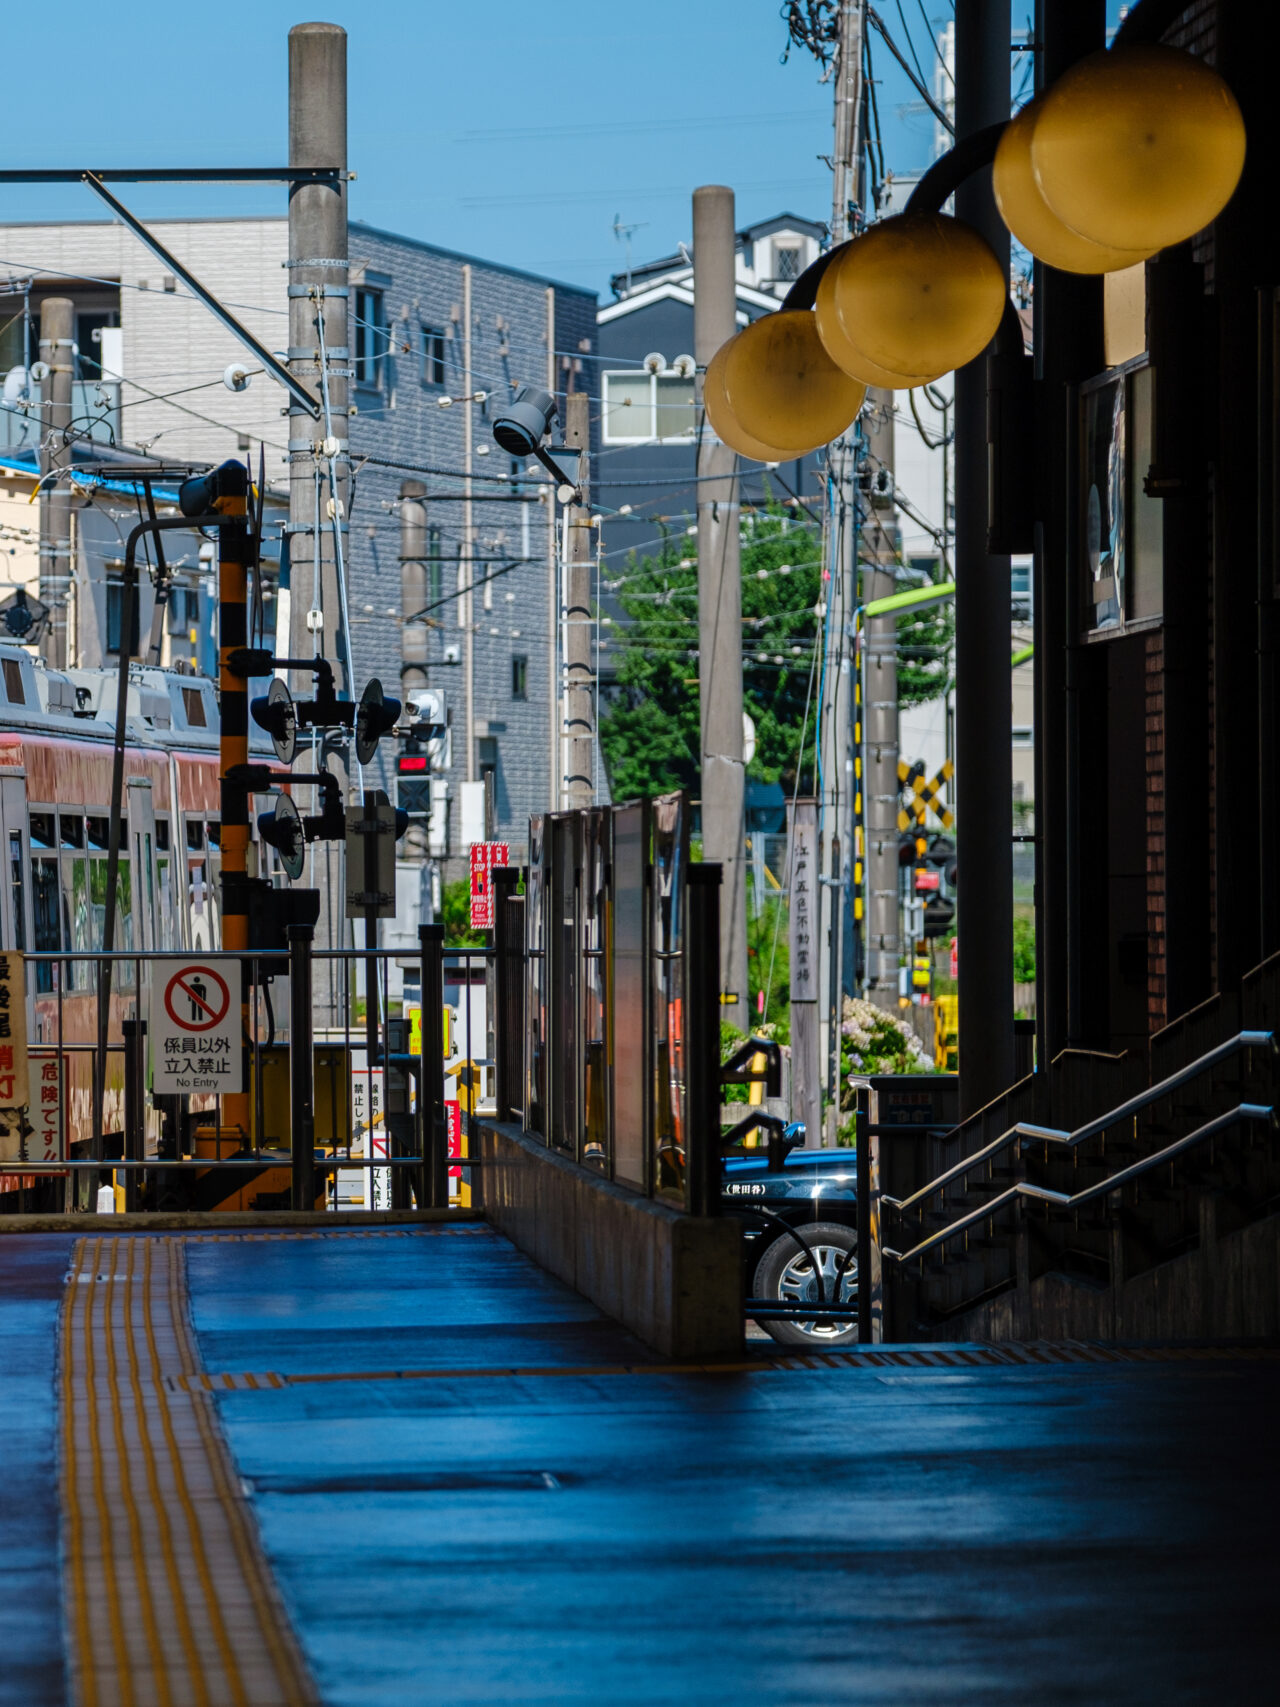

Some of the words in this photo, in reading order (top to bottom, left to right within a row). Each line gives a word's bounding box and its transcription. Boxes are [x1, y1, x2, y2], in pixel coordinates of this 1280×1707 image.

[474, 863, 485, 872] STOP
[164, 1037, 231, 1054] 係員以外
[164, 1057, 231, 1074] 立入禁止
[176, 1078, 190, 1087] No
[193, 1078, 218, 1088] Entry
